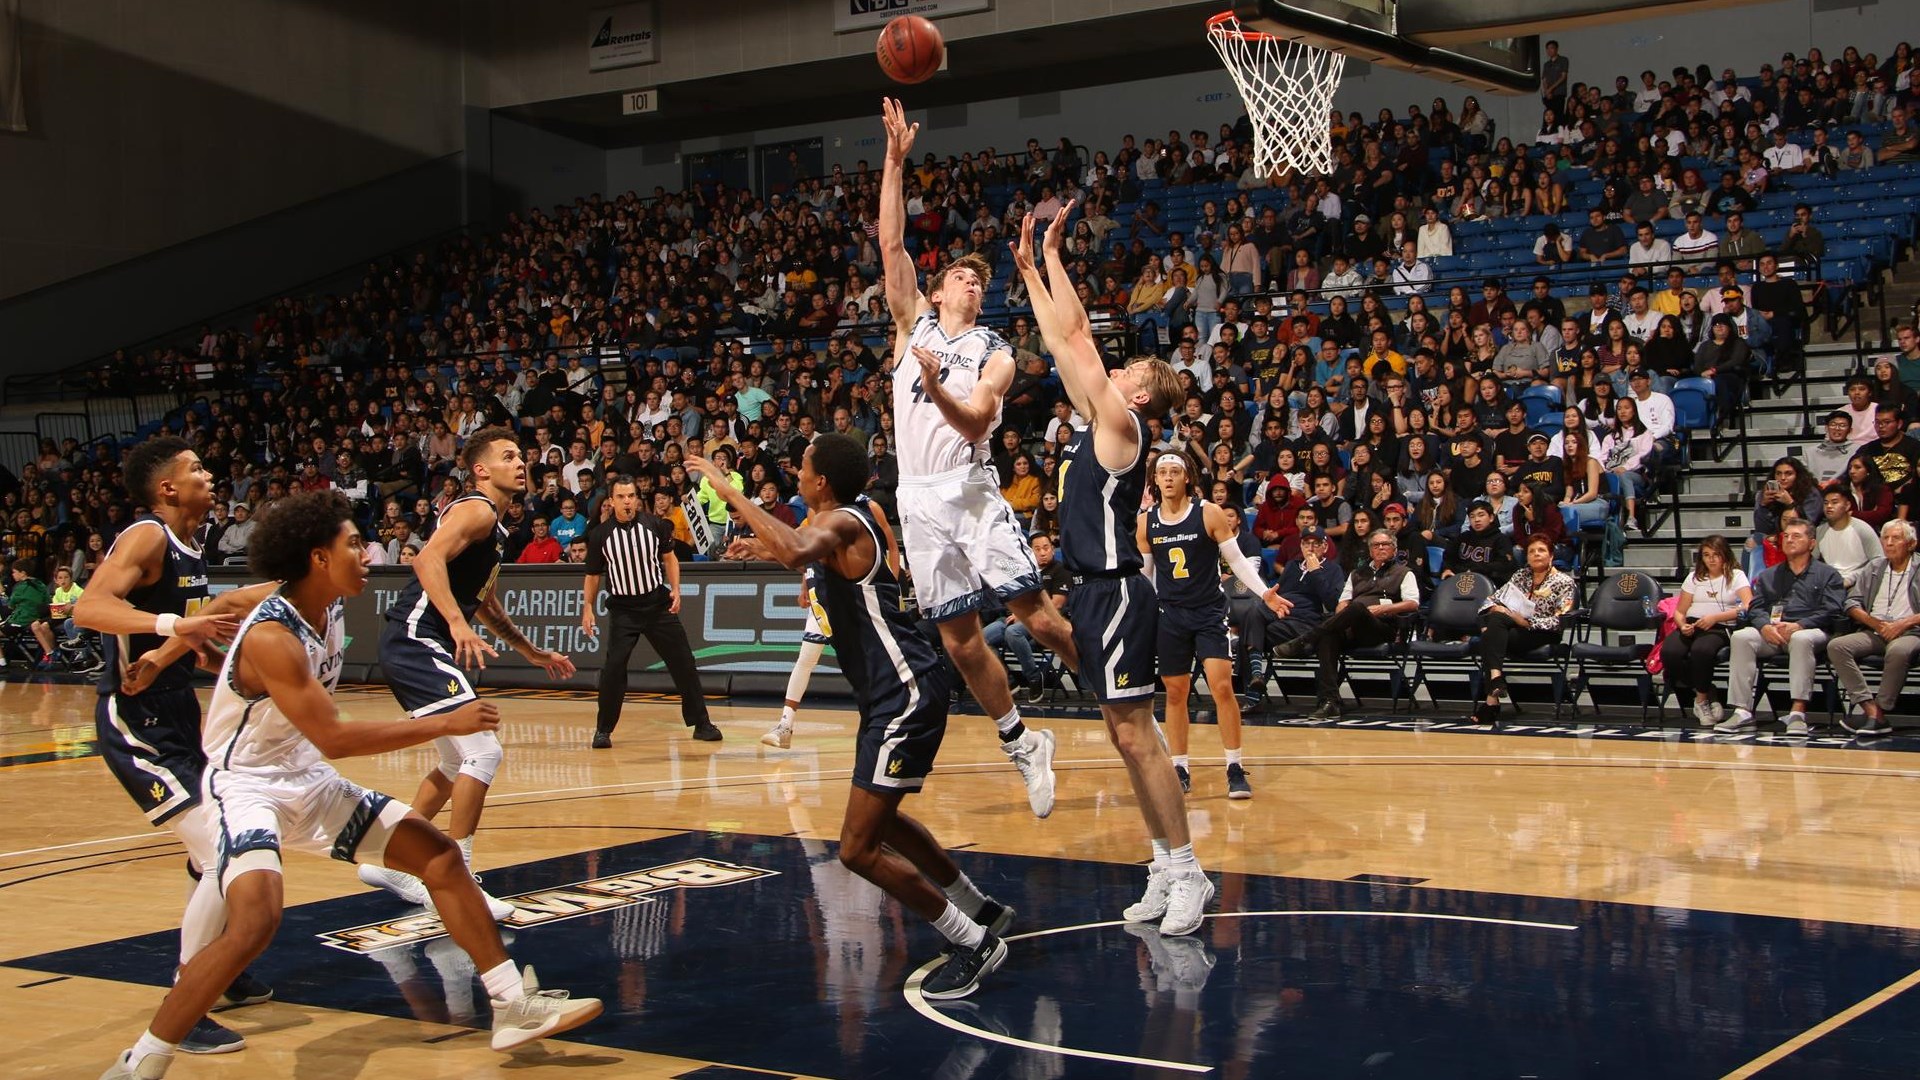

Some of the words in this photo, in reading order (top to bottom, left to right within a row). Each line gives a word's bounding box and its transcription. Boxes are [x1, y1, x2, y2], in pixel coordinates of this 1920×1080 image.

[610, 31, 651, 45] Rentals
[631, 94, 648, 111] 101
[932, 349, 973, 368] RVINE
[685, 492, 709, 548] Eater
[1168, 547, 1190, 579] 2
[1460, 542, 1492, 563] UCI
[374, 589, 402, 615] TH
[494, 625, 600, 653] AHLETICS
[338, 890, 637, 950] WST
